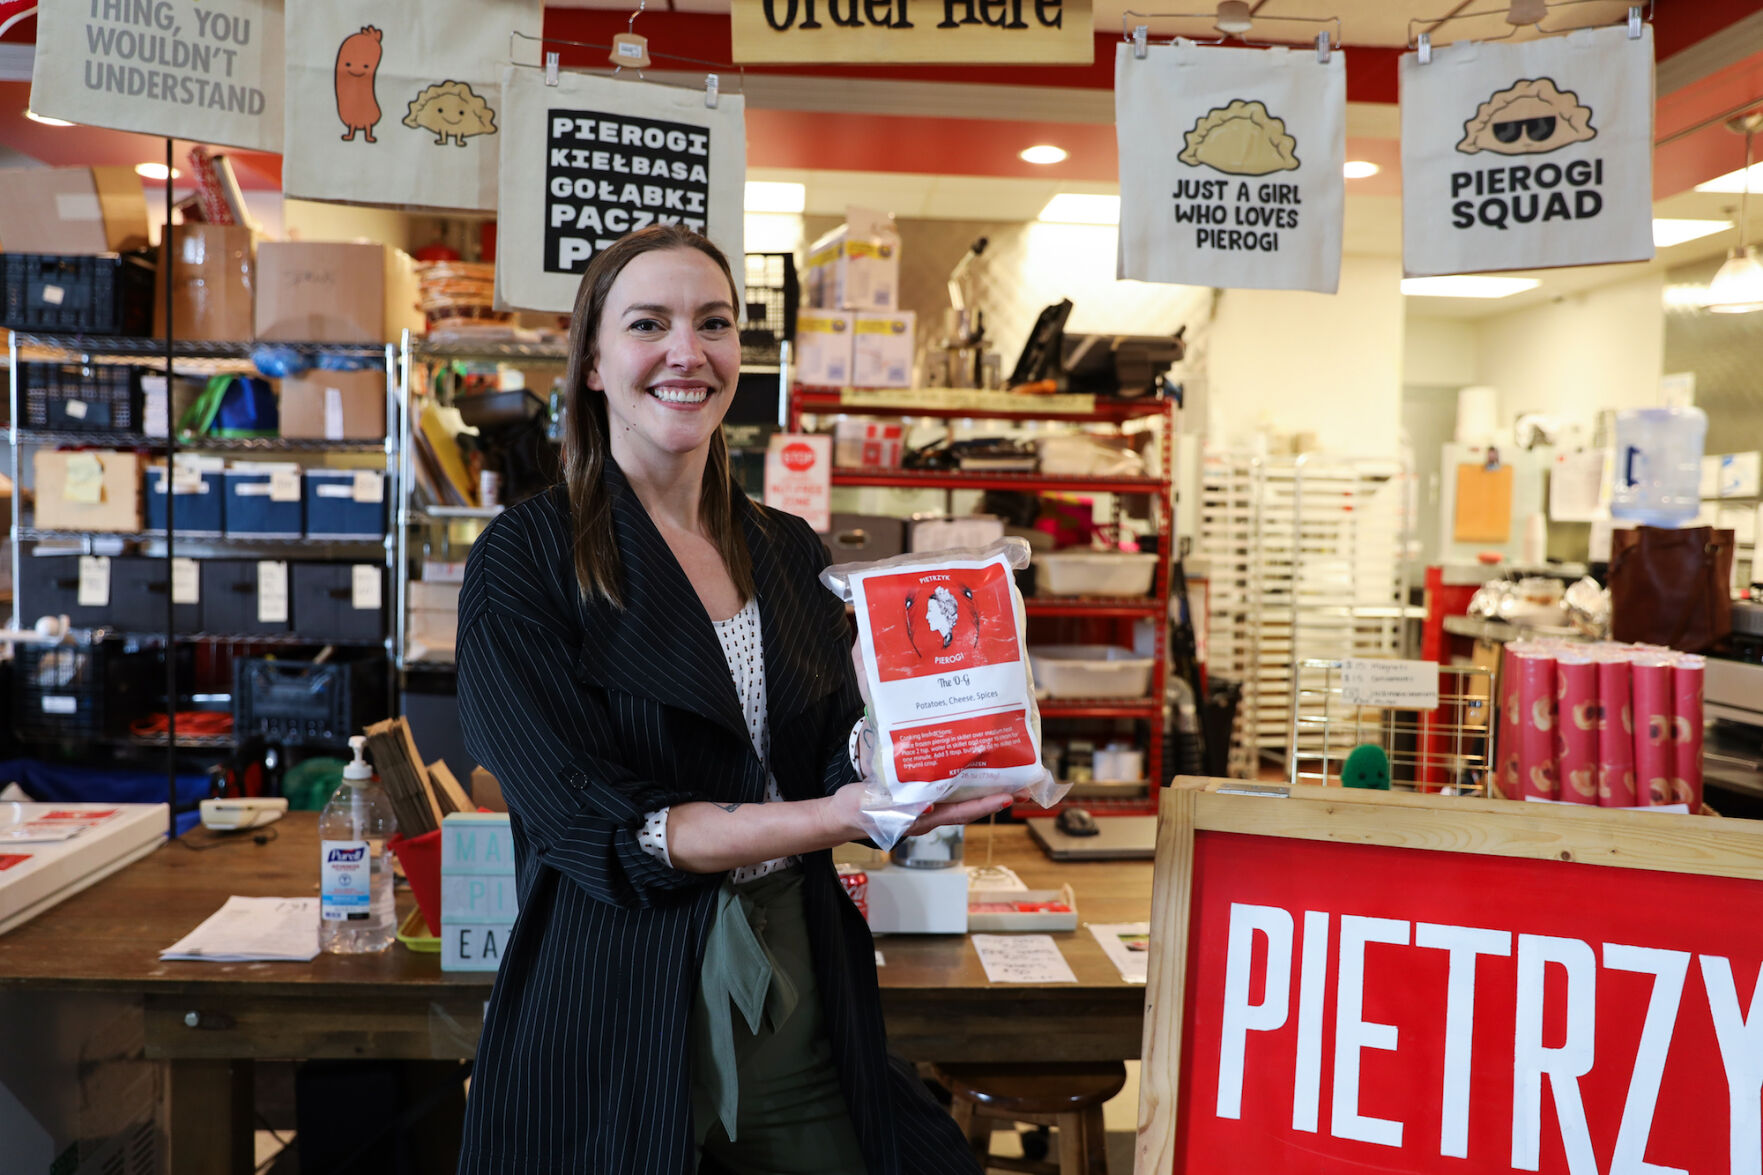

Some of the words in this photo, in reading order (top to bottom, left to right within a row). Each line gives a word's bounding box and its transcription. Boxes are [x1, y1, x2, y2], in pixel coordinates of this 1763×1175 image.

[90, 0, 182, 38] THING,
[194, 7, 251, 46] YOU
[86, 24, 238, 77] WOULDN'T
[84, 60, 266, 116] UNDERSTAND
[552, 117, 708, 156] PIEROGI
[550, 148, 708, 184] KIEŁBASA
[1451, 158, 1603, 198] PIEROGI
[550, 176, 706, 213] GOŁĄBKI
[1172, 179, 1229, 201] JUST
[1236, 181, 1251, 202] A
[1258, 183, 1302, 205] GIRL
[1174, 203, 1228, 225] WHO
[1234, 205, 1299, 229] LOVES
[1451, 189, 1603, 230] SQUAD
[1196, 228, 1279, 252] PIEROGI
[783, 451, 814, 464] STOP
[919, 575, 951, 585] PIETRZYK
[934, 652, 965, 665] PIEROGI
[915, 698, 948, 710] Potatoes,
[949, 694, 976, 705] Cheese,
[976, 689, 999, 701] Spices
[937, 678, 952, 688] The
[460, 929, 513, 959] EA
[1216, 902, 1763, 1175] PIETRZY
